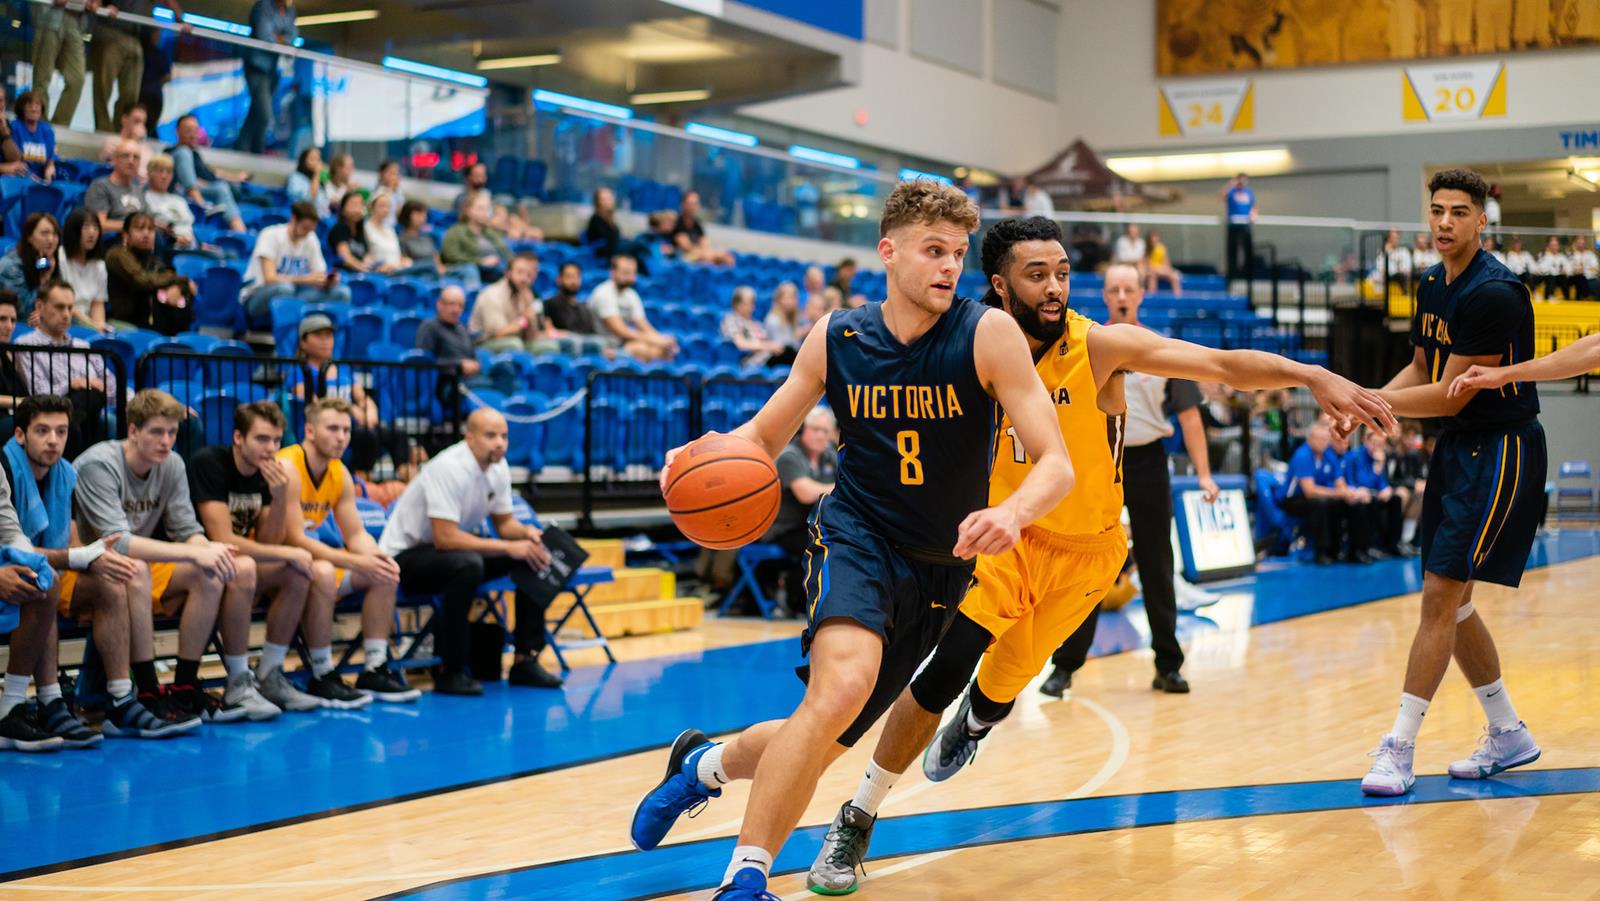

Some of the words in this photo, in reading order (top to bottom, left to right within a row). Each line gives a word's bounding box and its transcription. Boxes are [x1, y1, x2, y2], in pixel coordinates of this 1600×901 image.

[1187, 101, 1225, 129] 24
[1434, 87, 1476, 113] 20
[847, 384, 963, 419] VICTORIA
[897, 430, 924, 486] 8
[1006, 426, 1033, 464] 1
